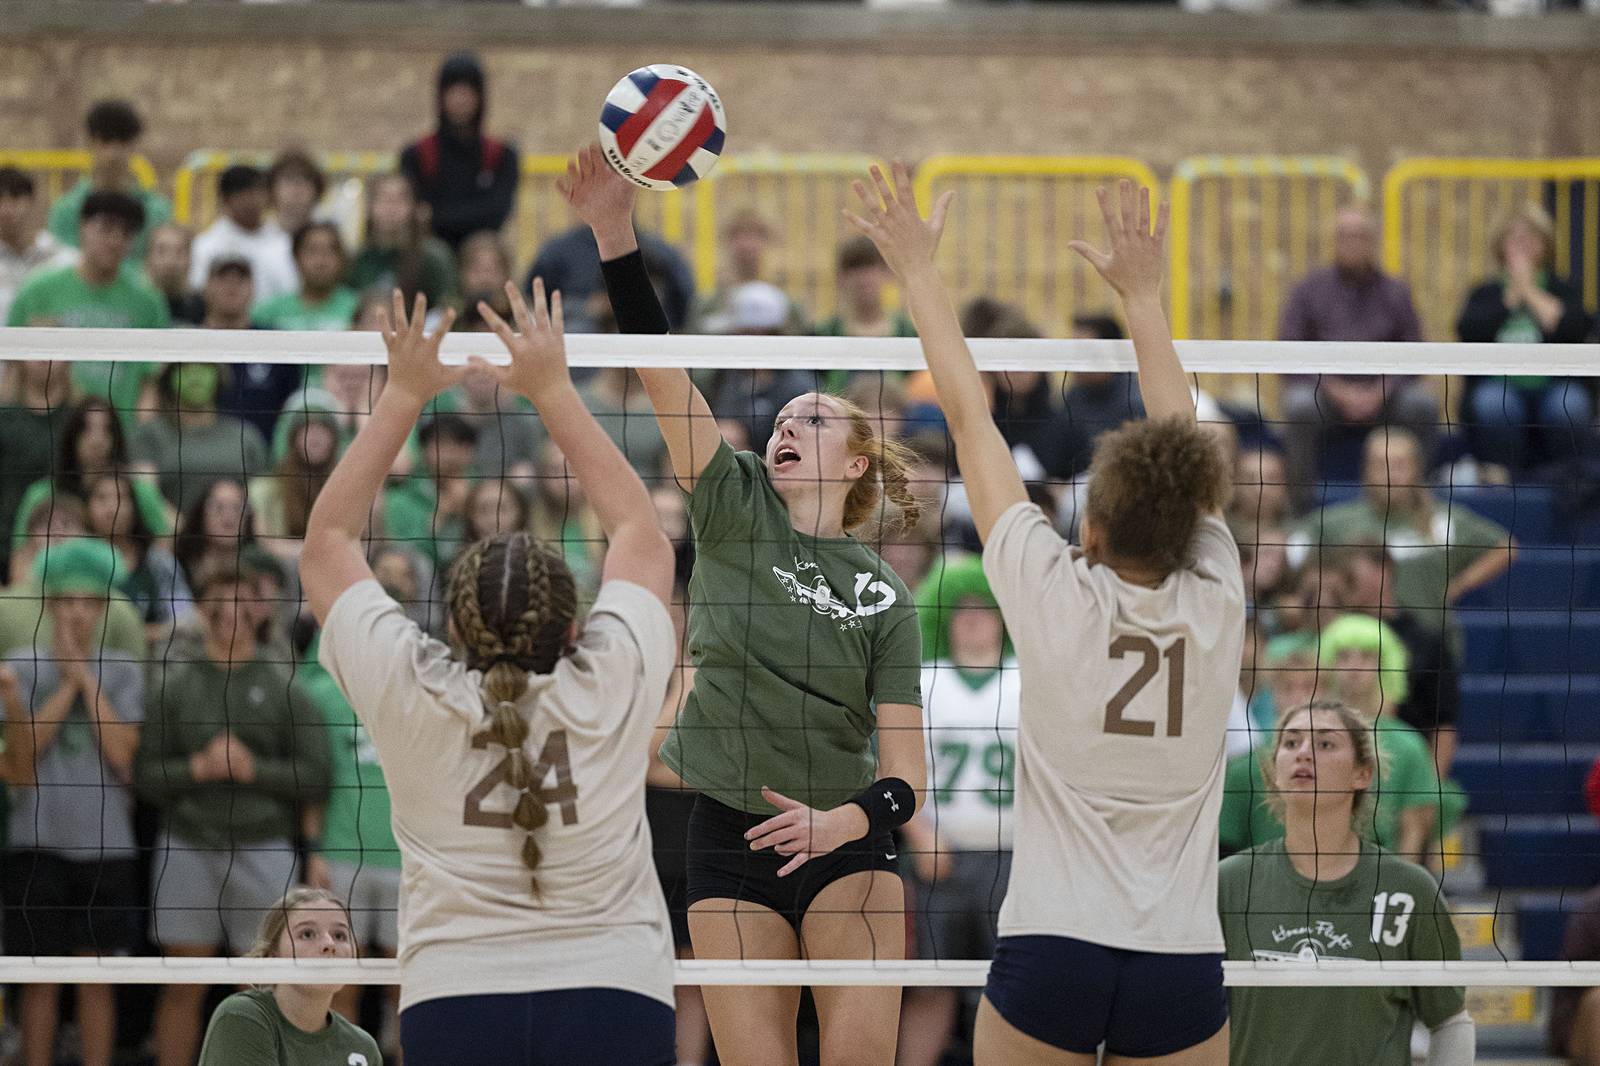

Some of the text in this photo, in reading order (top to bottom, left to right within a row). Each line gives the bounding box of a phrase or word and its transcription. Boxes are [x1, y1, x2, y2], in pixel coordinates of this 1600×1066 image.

[1103, 633, 1186, 737] 21
[463, 729, 578, 829] 24
[935, 741, 1015, 806] 79
[1370, 891, 1415, 947] 13
